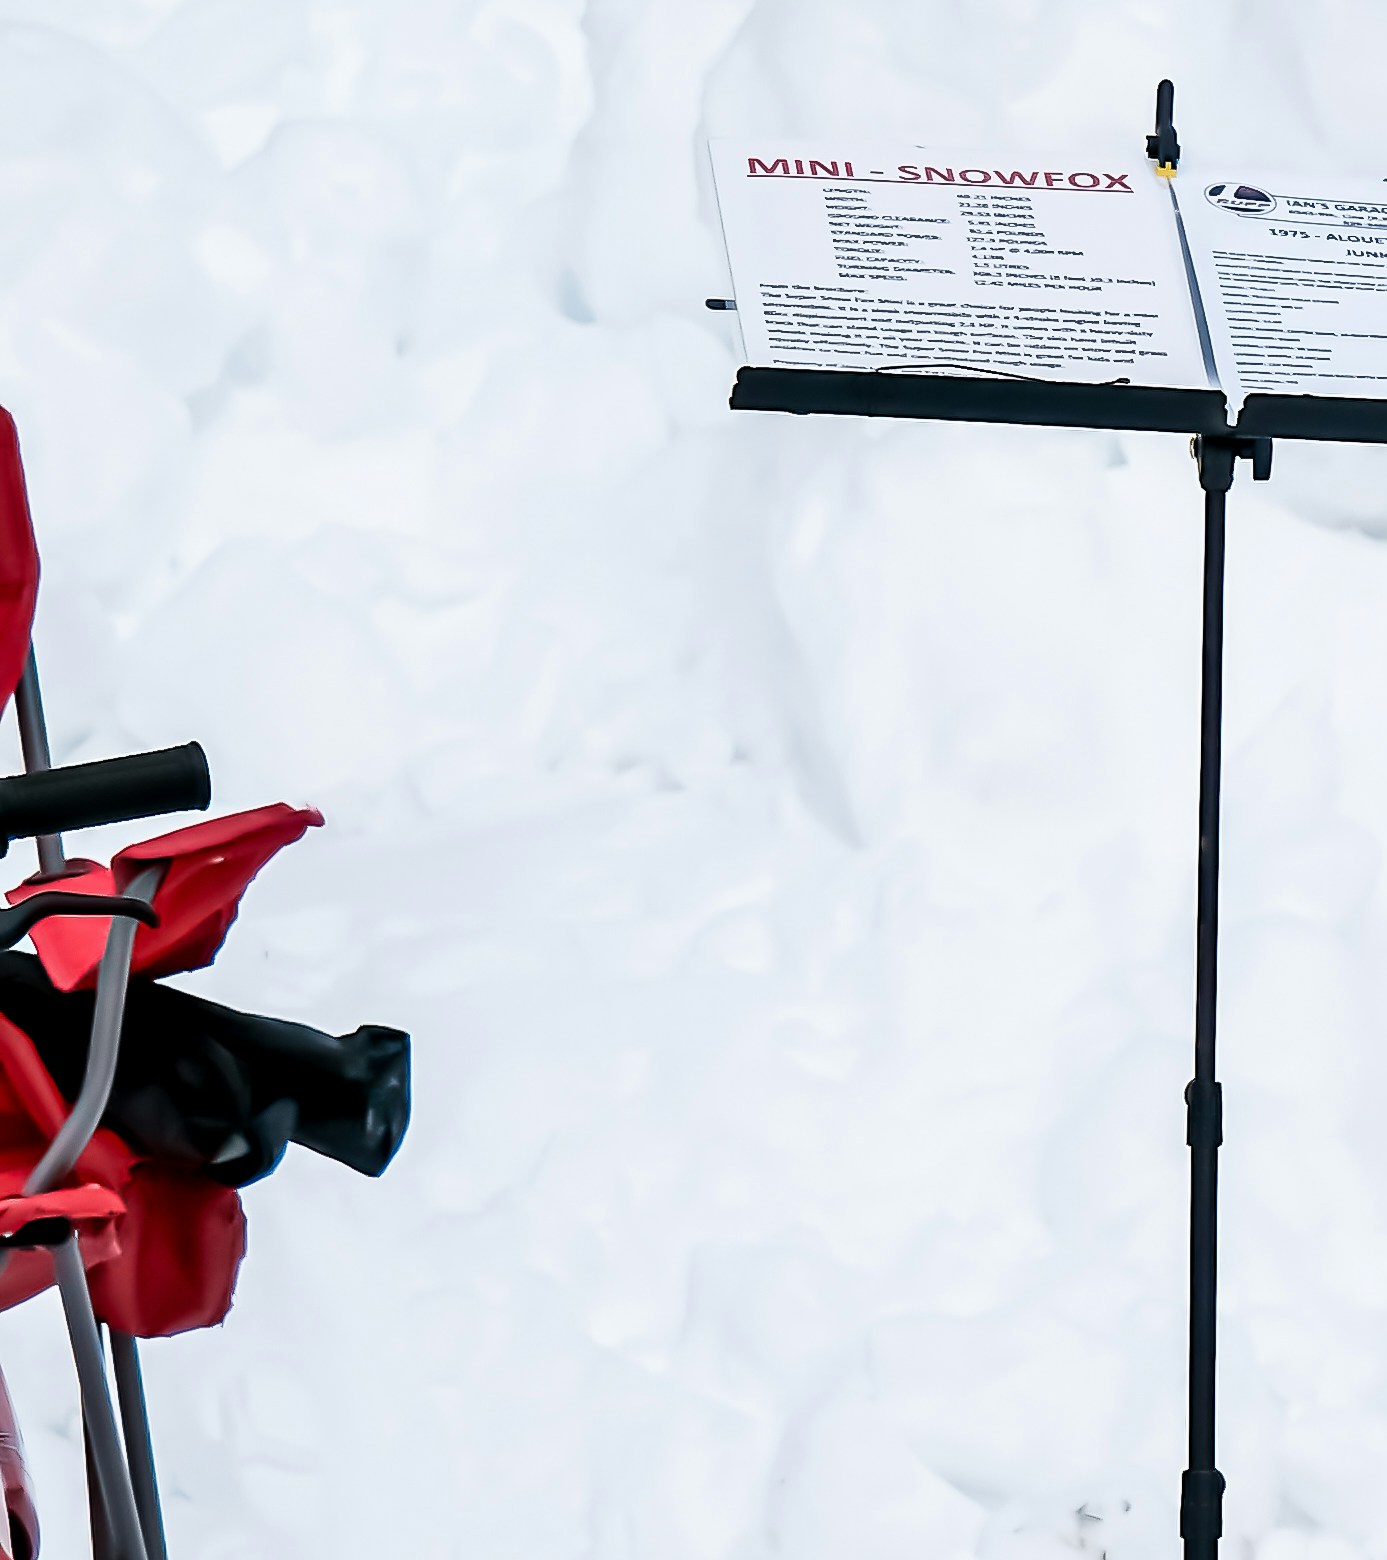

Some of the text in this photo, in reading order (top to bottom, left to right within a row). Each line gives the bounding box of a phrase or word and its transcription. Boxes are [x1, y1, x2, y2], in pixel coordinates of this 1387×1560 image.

[748, 157, 854, 178] MINI
[898, 165, 1132, 190] SNOWFOX
[1269, 228, 1311, 239] 1975
